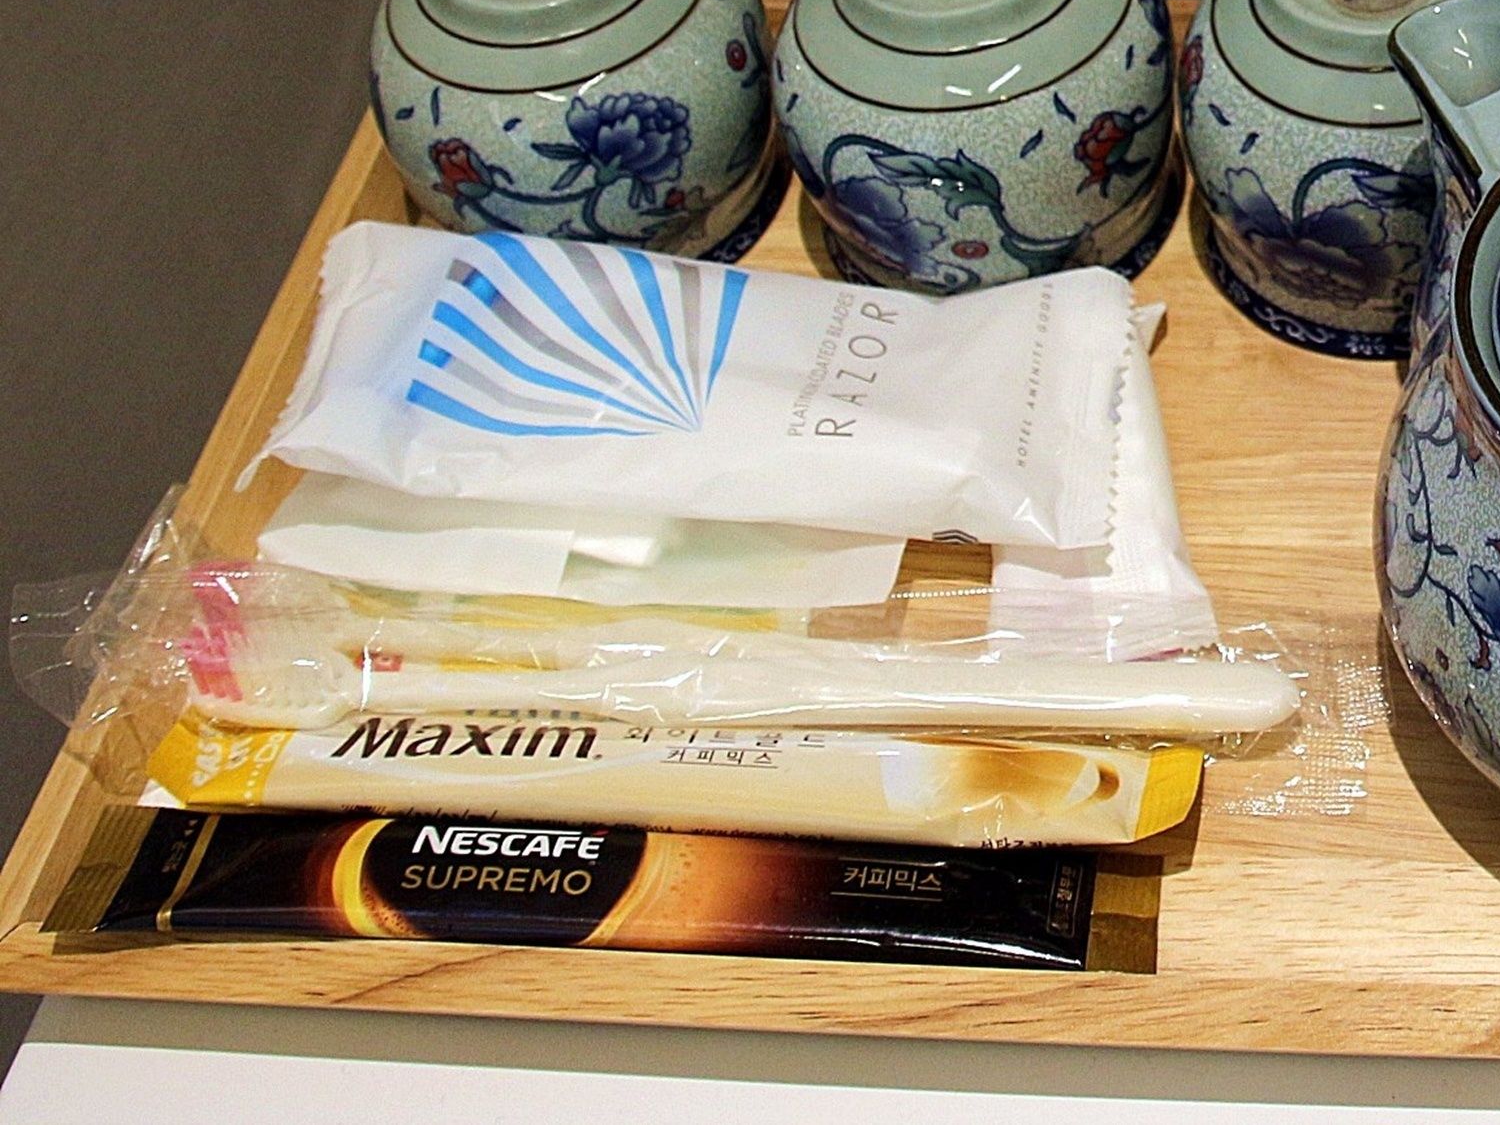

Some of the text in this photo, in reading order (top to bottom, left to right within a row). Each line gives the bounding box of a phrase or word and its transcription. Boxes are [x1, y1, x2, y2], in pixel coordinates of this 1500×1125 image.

[815, 302, 899, 437] RAZOR
[331, 717, 597, 759] Maxim
[667, 748, 773, 766] 커피믹스
[401, 865, 592, 896] SUPREMO
[843, 865, 942, 891] 커피믹스
